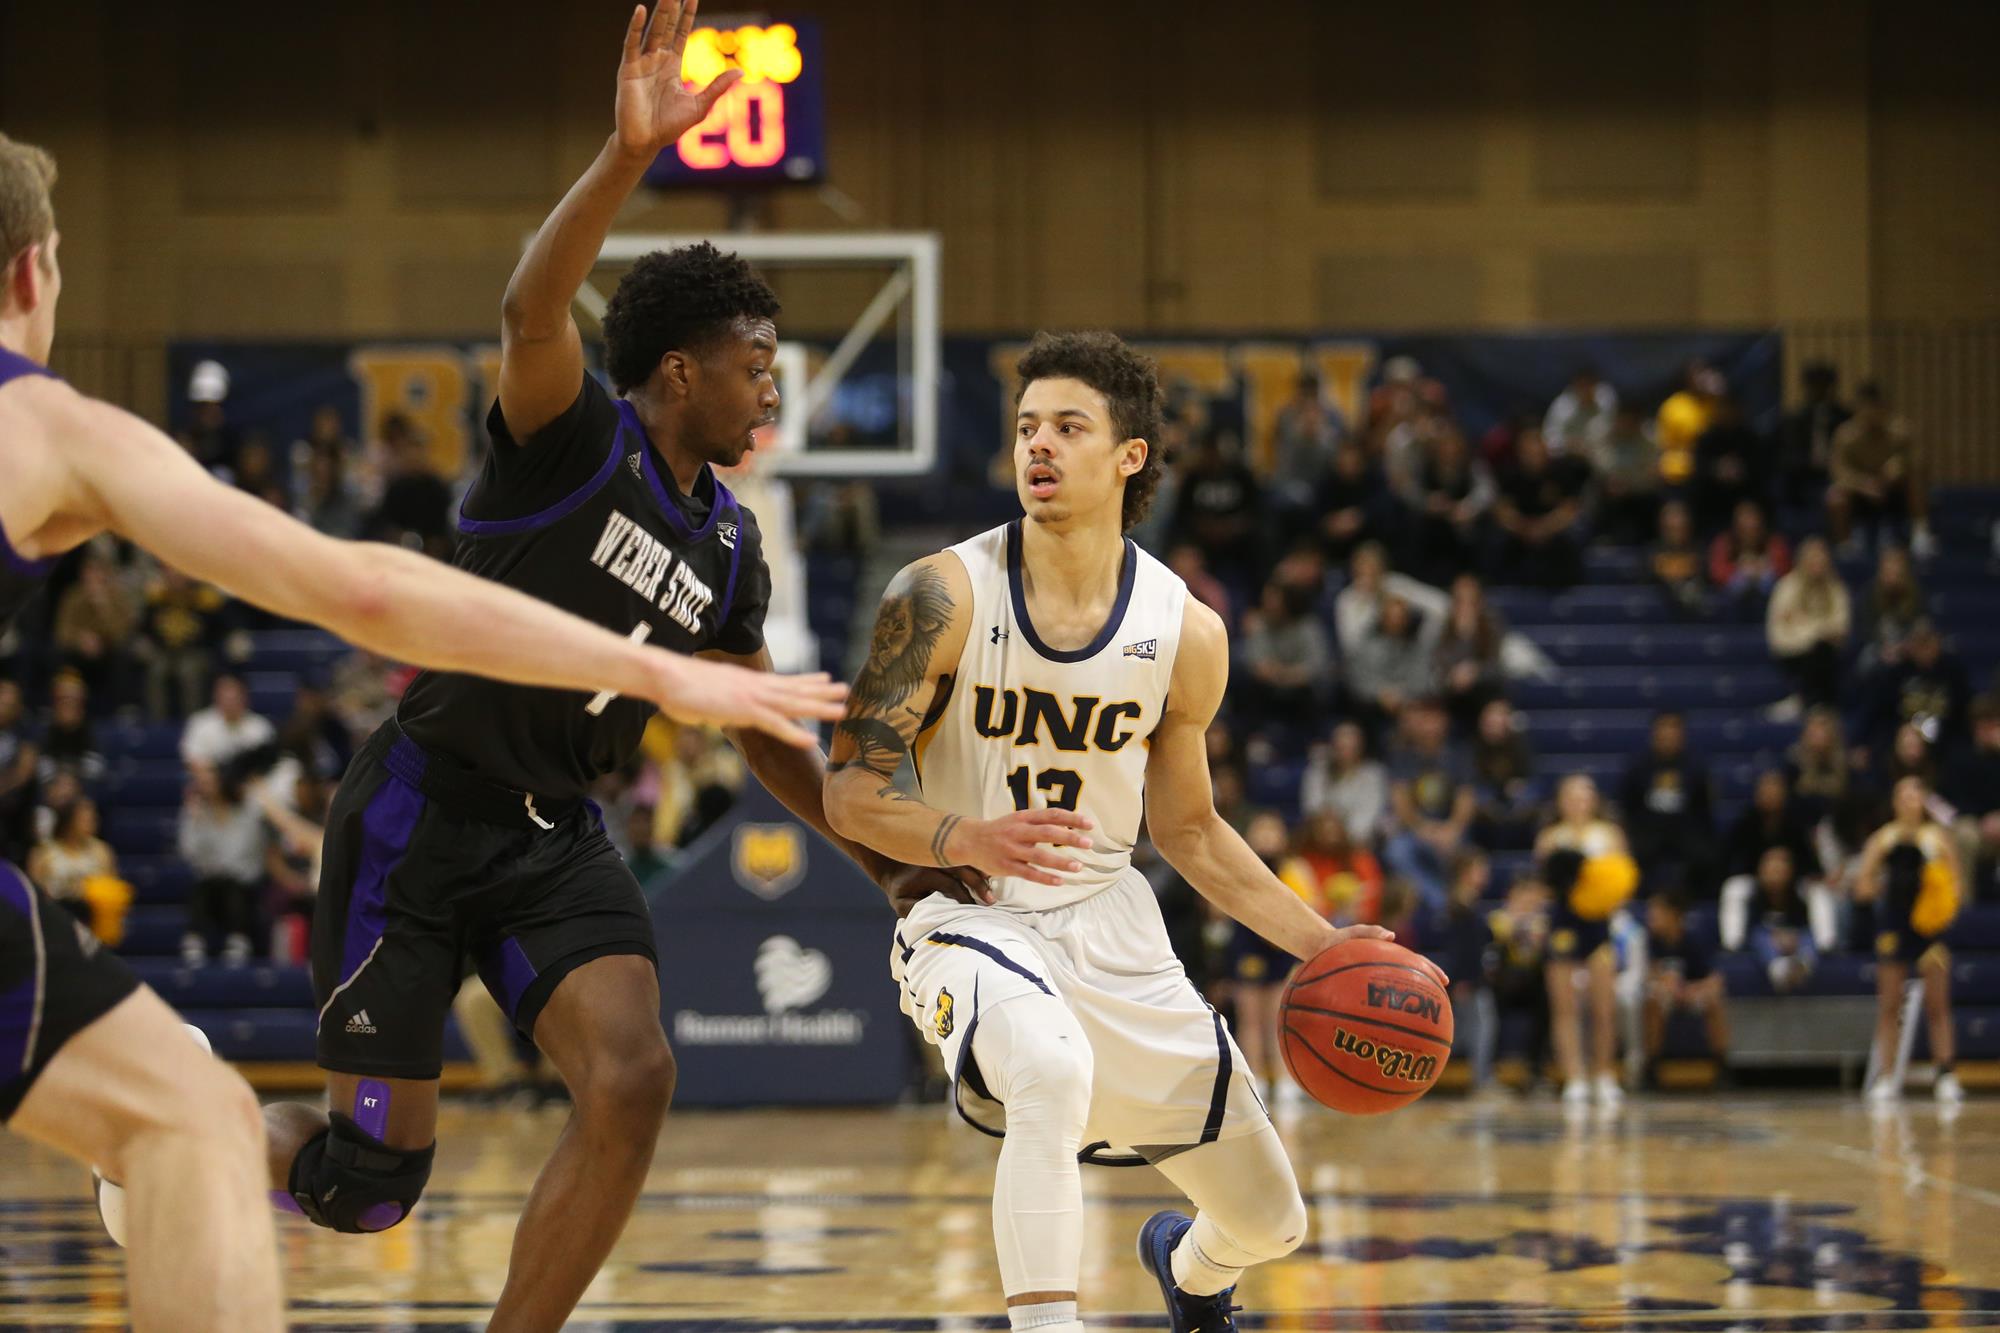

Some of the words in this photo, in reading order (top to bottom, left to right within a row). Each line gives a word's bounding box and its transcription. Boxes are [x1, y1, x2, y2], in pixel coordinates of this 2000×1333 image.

[677, 80, 785, 168] 20
[590, 508, 673, 604] WEBER
[974, 684, 1142, 752] UNC
[345, 1023, 377, 1034] adidas
[1367, 981, 1442, 1025] NCAA
[1334, 1026, 1438, 1082] Wilson
[363, 1096, 378, 1108] KT
